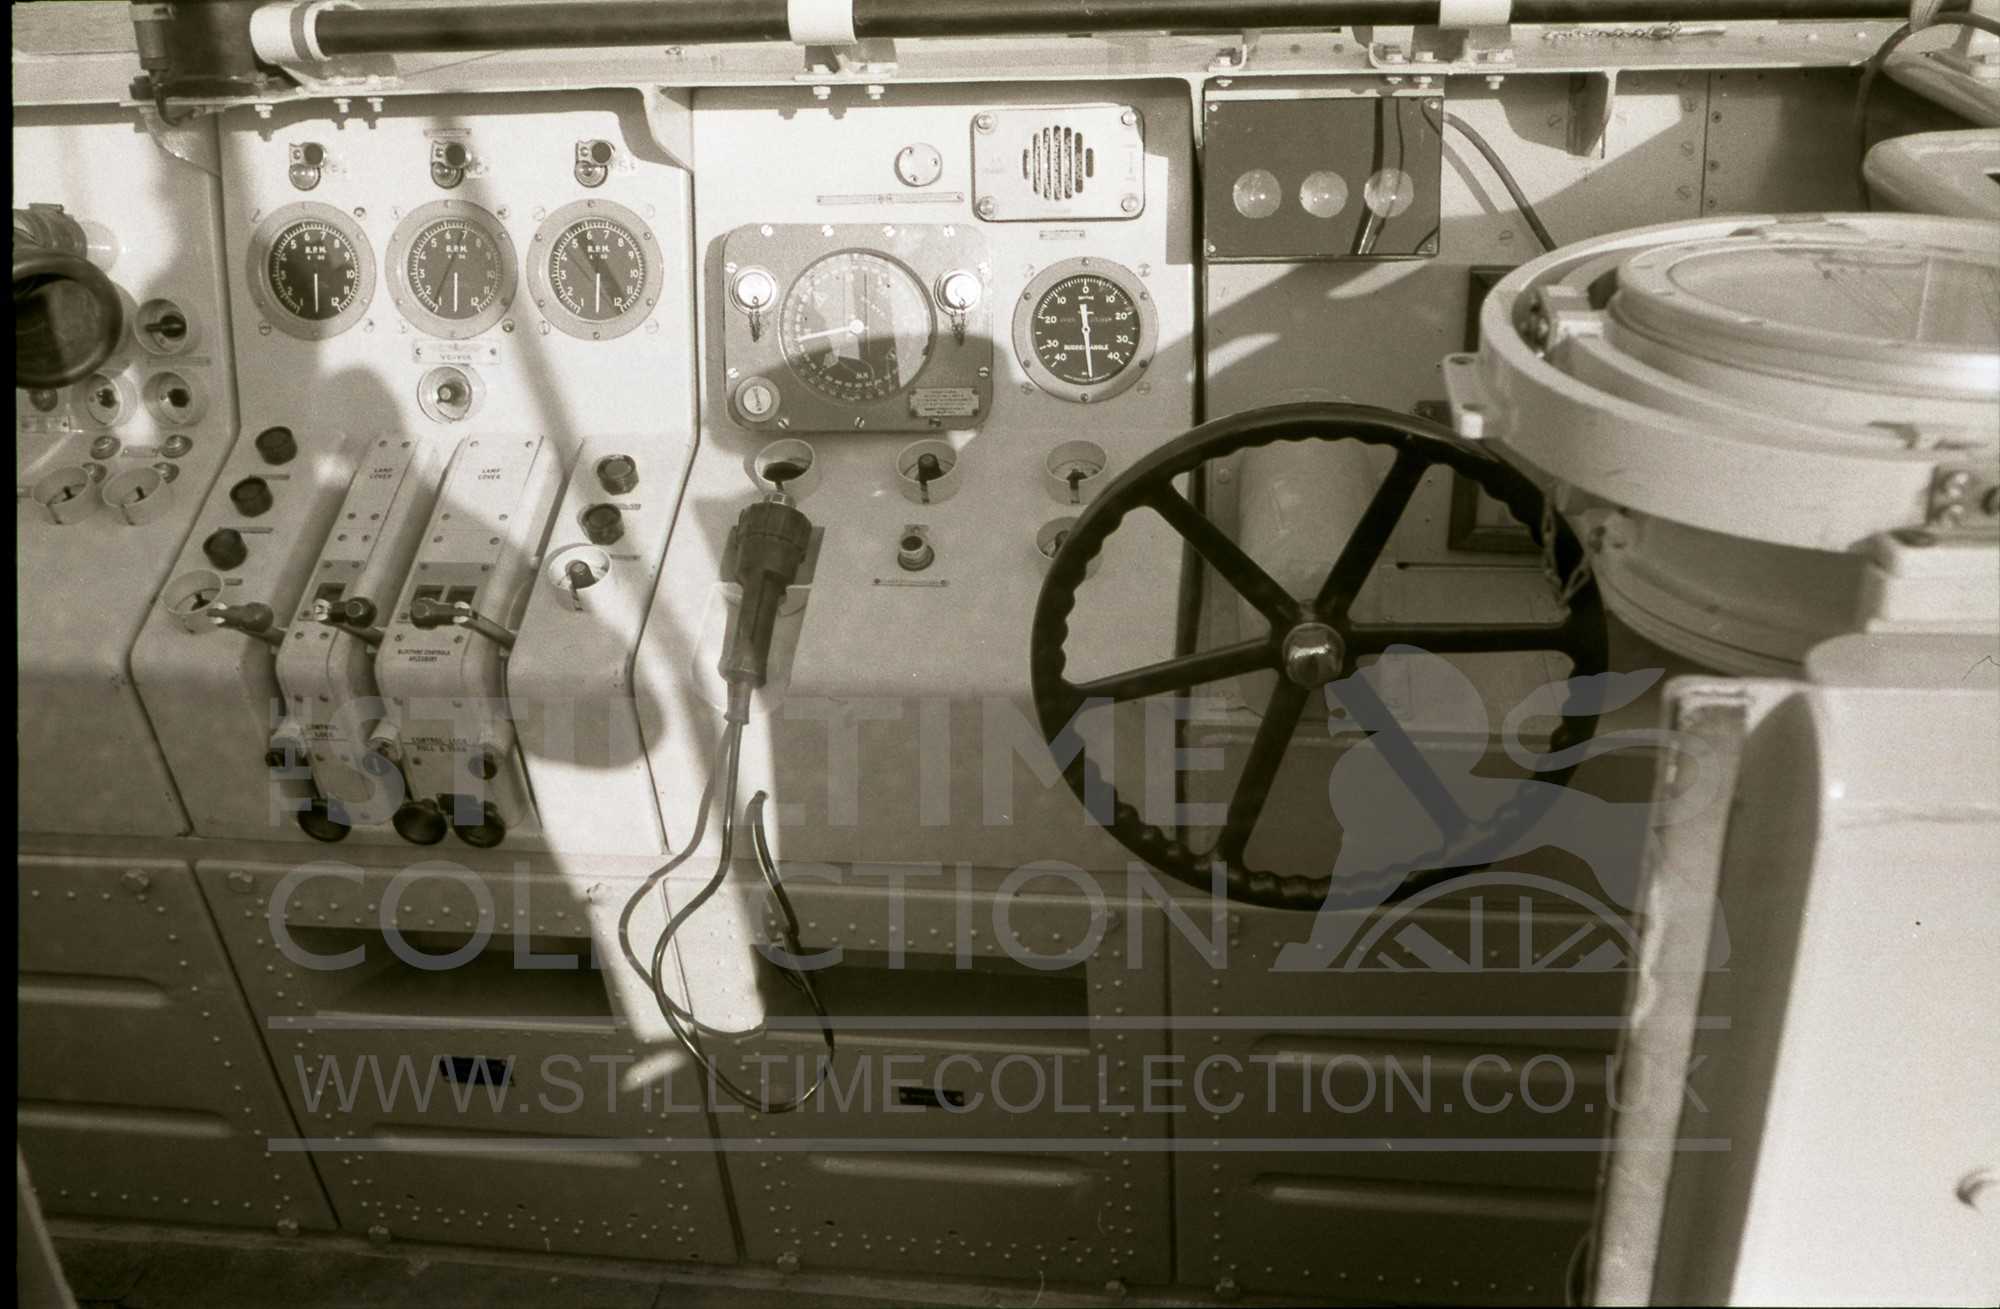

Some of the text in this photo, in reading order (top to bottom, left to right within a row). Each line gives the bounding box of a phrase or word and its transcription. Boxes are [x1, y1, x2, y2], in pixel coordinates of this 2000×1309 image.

[304, 232, 311, 241] 6
[321, 232, 326, 240] 7
[445, 230, 451, 239] 6
[462, 231, 467, 240] 7
[587, 231, 592, 240] 6
[604, 230, 609, 239] 7
[291, 239, 297, 249] 5
[334, 239, 340, 248] 8
[431, 238, 437, 248] 5
[572, 239, 578, 248] 5
[618, 238, 624, 247] 8
[344, 252, 350, 261] 9
[420, 251, 426, 260] 4
[561, 253, 567, 261] 4
[628, 251, 634, 259] 9
[347, 270, 354, 279] 10
[419, 269, 425, 279] 3
[560, 270, 566, 279] 3
[631, 269, 638, 278] 10
[288, 286, 293, 296] 2
[344, 286, 350, 294] 11
[425, 285, 431, 295] 2
[568, 287, 573, 296] 2
[627, 286, 633, 294] 11
[331, 297, 339, 306] 12
[471, 297, 479, 306] 12
[614, 297, 622, 306] 12
[1106, 295, 1115, 303] 10
[1115, 312, 1127, 320] 20
[1117, 335, 1128, 343] 30
[1055, 353, 1066, 361] 40
[1107, 352, 1120, 360] 40
